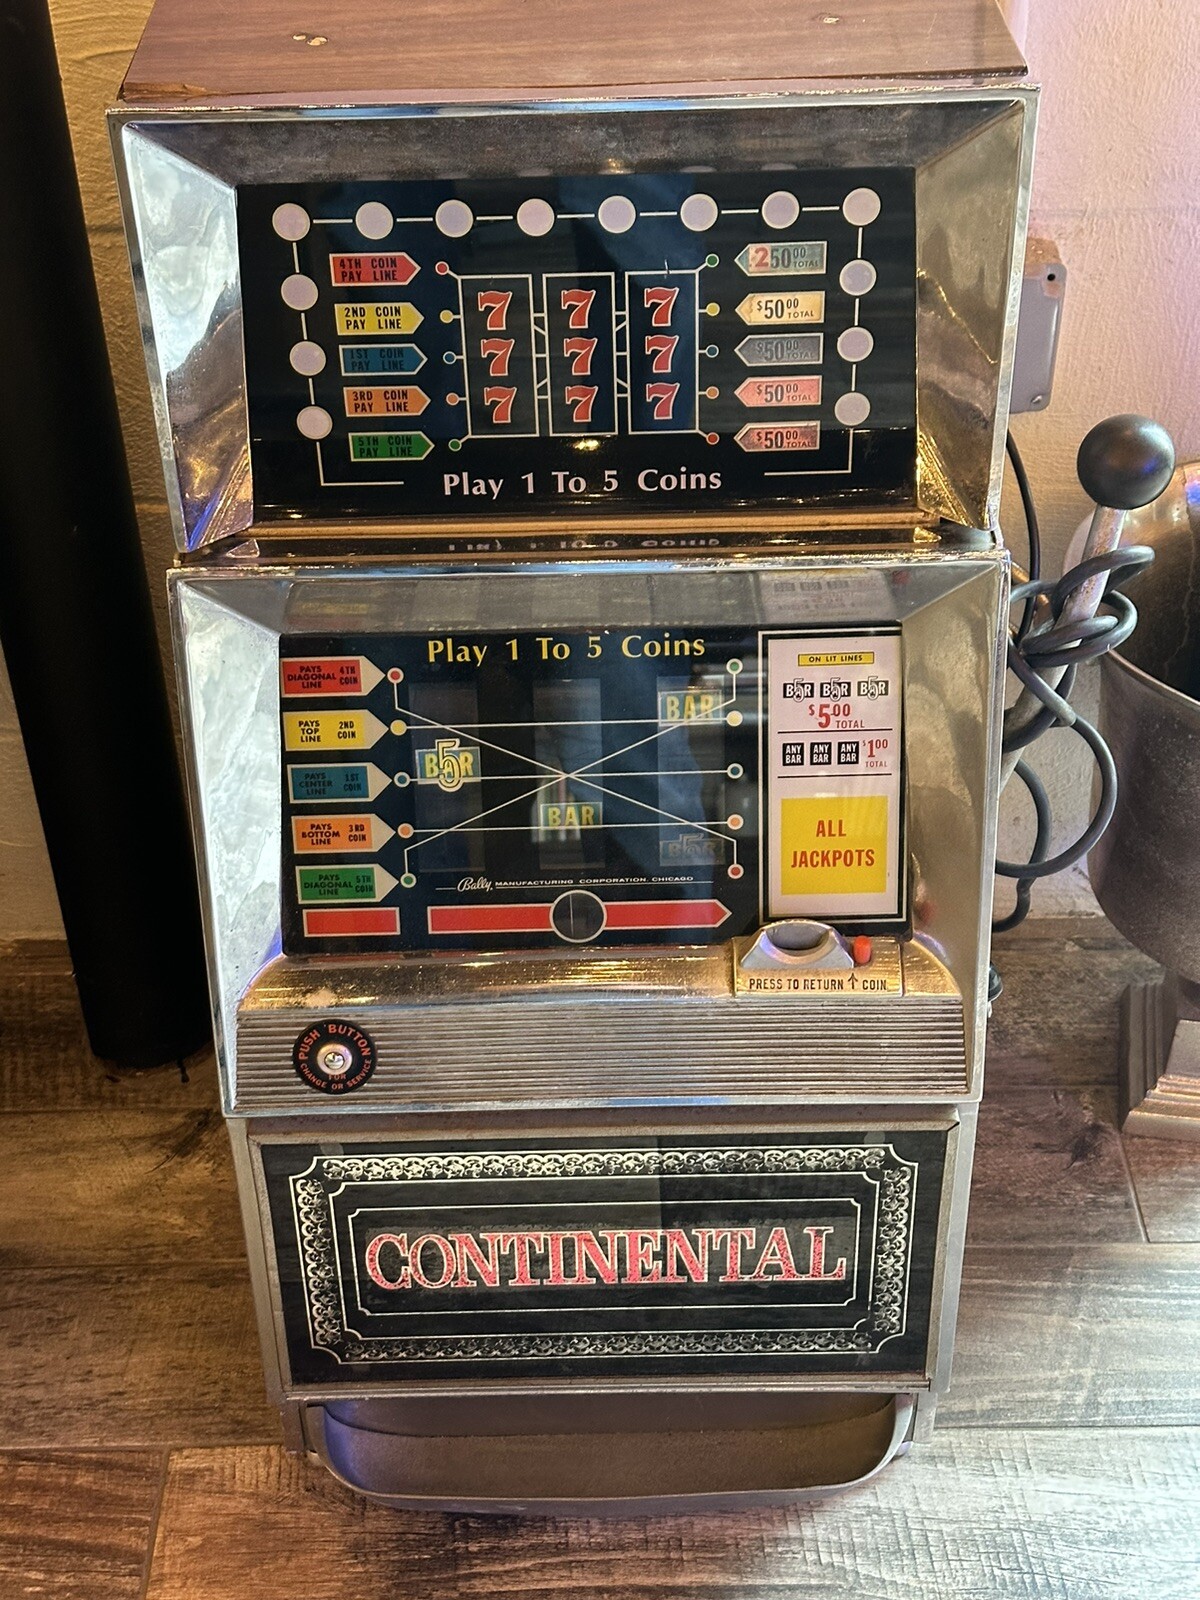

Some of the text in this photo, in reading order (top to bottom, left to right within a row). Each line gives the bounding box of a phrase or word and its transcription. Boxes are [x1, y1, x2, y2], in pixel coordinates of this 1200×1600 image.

[340, 258, 397, 269] 4TH COIN
[794, 260, 819, 268] TOTAL
[341, 270, 397, 282] PAY LINE
[345, 306, 401, 317] 2ND COIN
[477, 287, 679, 330] 7 7 7
[346, 319, 401, 330] PAY LINE
[350, 348, 404, 359] 1ST COIN
[481, 334, 679, 376] 7 7 7
[351, 360, 404, 371] PAY LINE
[352, 390, 408, 401] 3RD COIN
[787, 394, 812, 402] TOTAL
[354, 402, 409, 413] PAY LINE
[484, 382, 680, 424] 7 7 7
[358, 435, 412, 446] 5TH COIN
[786, 439, 811, 447] TOTAL
[359, 447, 412, 457] PAY LINE
[444, 466, 722, 499] Play 1 To 5 Coins
[428, 632, 705, 666] Play 1 To 5 Coins
[339, 667, 356, 675] 4TH
[287, 673, 336, 681] DIAGONAL
[339, 677, 358, 685] COIN
[302, 681, 322, 689] LINE
[666, 695, 714, 721] BAR
[339, 721, 354, 729] 2ND
[836, 720, 865, 728] TOTAL
[337, 731, 356, 739] COIN
[786, 743, 857, 753] ANY ANY ANY
[786, 753, 856, 763] BAR BAR BAR
[345, 774, 360, 782] 1ST
[299, 780, 333, 788] CENTER
[343, 783, 362, 791] COIN
[548, 806, 594, 829] BAR
[349, 824, 364, 832] 3RD
[816, 820, 846, 837] ALL
[348, 834, 366, 842] COIN
[791, 849, 875, 868] JACKPOTS
[458, 877, 492, 891] Bally
[750, 978, 887, 990] PRESS TO RETURN COIN
[299, 1024, 371, 1060] PUSH BUTTON
[300, 1063, 327, 1088] CHANGE
[346, 1060, 372, 1087] SERVICE
[365, 1226, 846, 1289] CONTINENTAL
